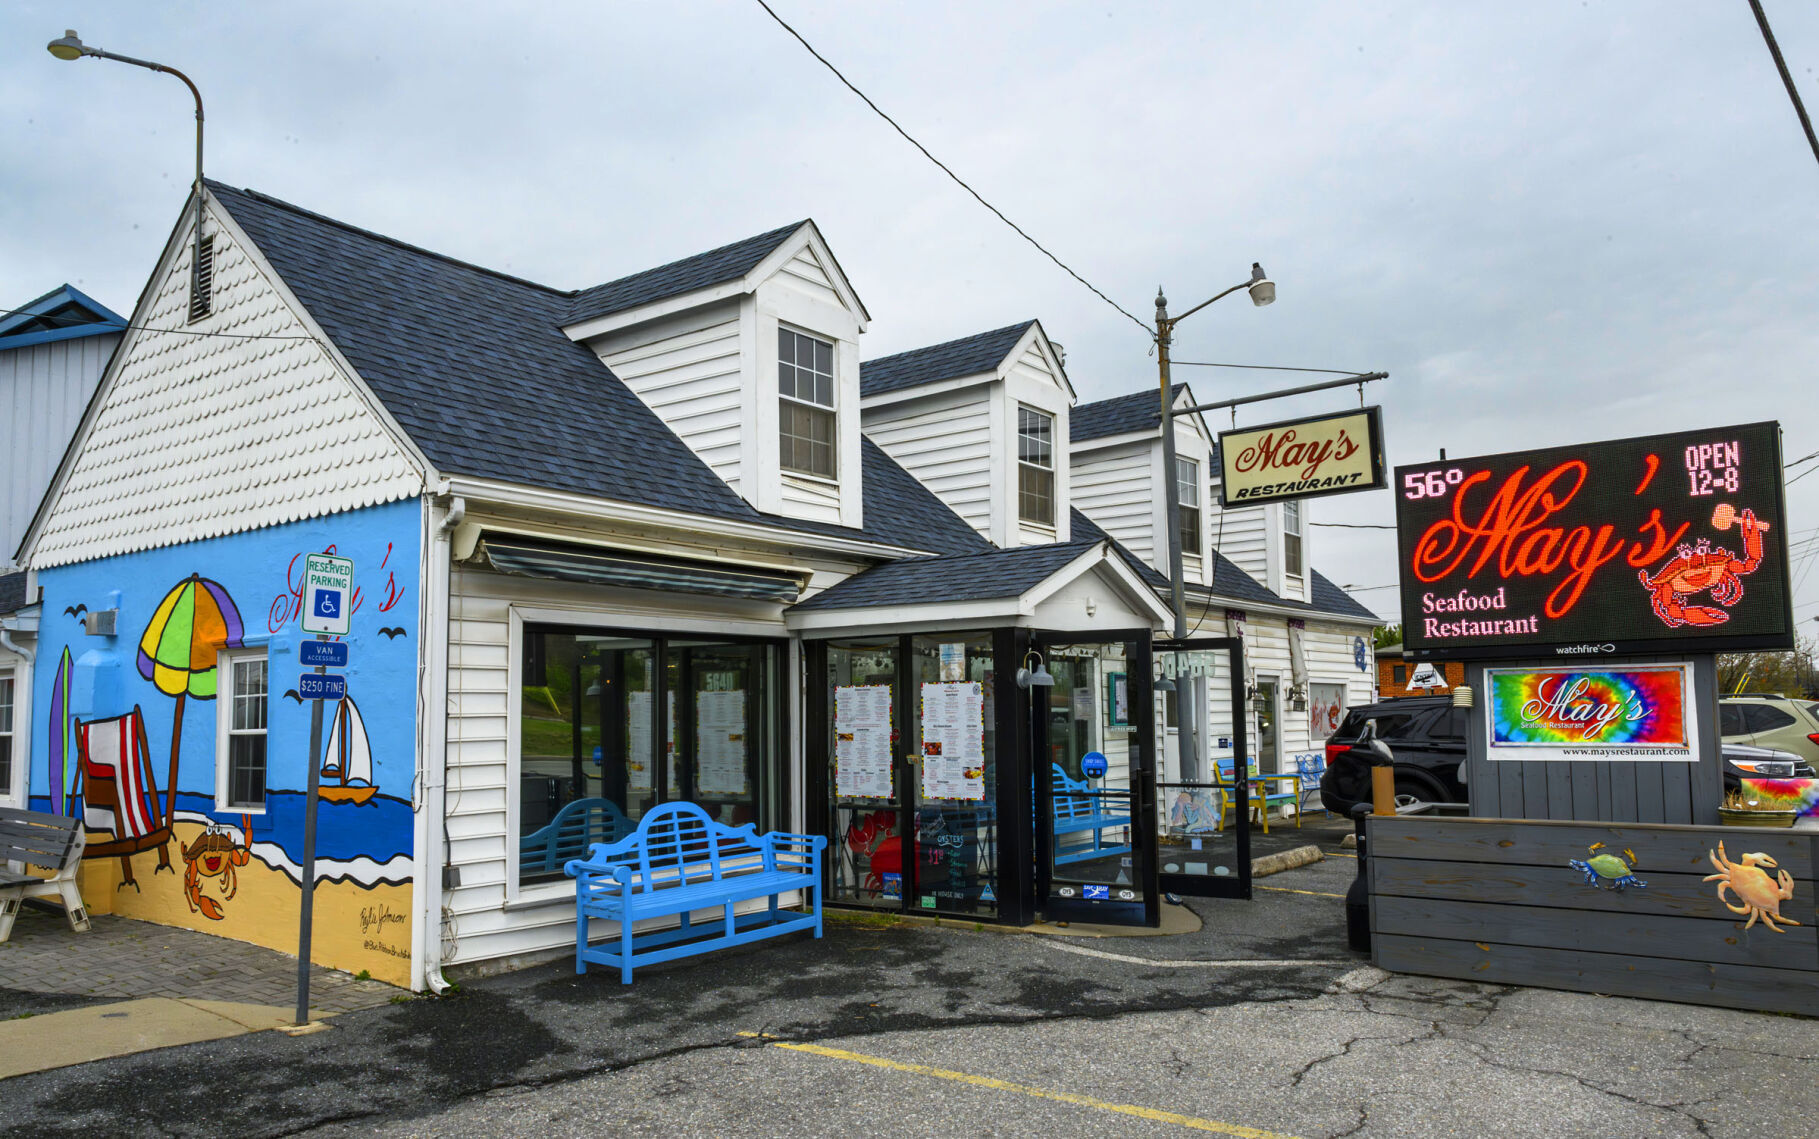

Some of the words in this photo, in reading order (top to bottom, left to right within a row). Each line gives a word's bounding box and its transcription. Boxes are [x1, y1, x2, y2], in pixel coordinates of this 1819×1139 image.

[1235, 429, 1360, 481] May's
[1685, 441, 1739, 470] OPEN
[1236, 472, 1363, 499] RESTAURANT
[1689, 467, 1739, 496] 12-8
[1413, 453, 1691, 620] May's
[309, 561, 350, 576] RESERVED
[310, 574, 347, 589] PARKING
[1422, 587, 1507, 613] Seafood
[1424, 615, 1538, 638] Restaurant
[316, 646, 333, 655] VAN
[301, 680, 322, 692] $250
[326, 681, 343, 693] FINE
[1520, 677, 1653, 740] May's
[1521, 721, 1547, 729] Seafood
[1549, 721, 1585, 729] Restaurant
[1563, 748, 1690, 758] www.maysrestaurant.com
